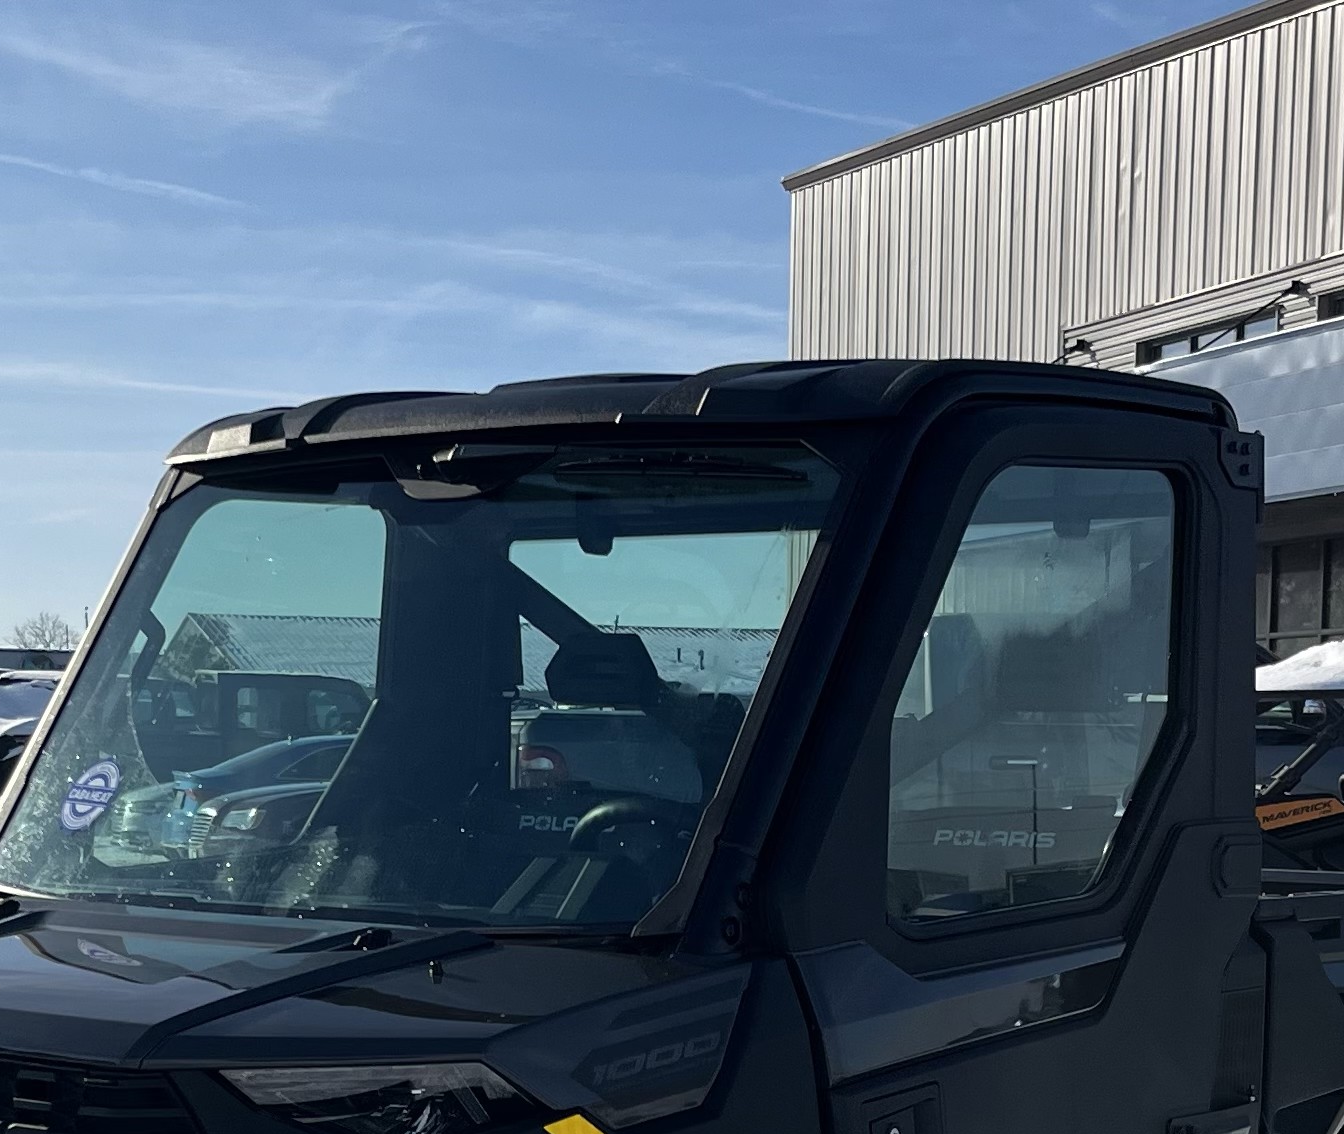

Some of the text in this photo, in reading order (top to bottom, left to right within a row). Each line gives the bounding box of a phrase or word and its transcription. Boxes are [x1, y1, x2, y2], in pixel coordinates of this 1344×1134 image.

[1262, 800, 1333, 824] MAVERICK
[933, 829, 1057, 849] POLARIS
[592, 1030, 721, 1087] 1000
